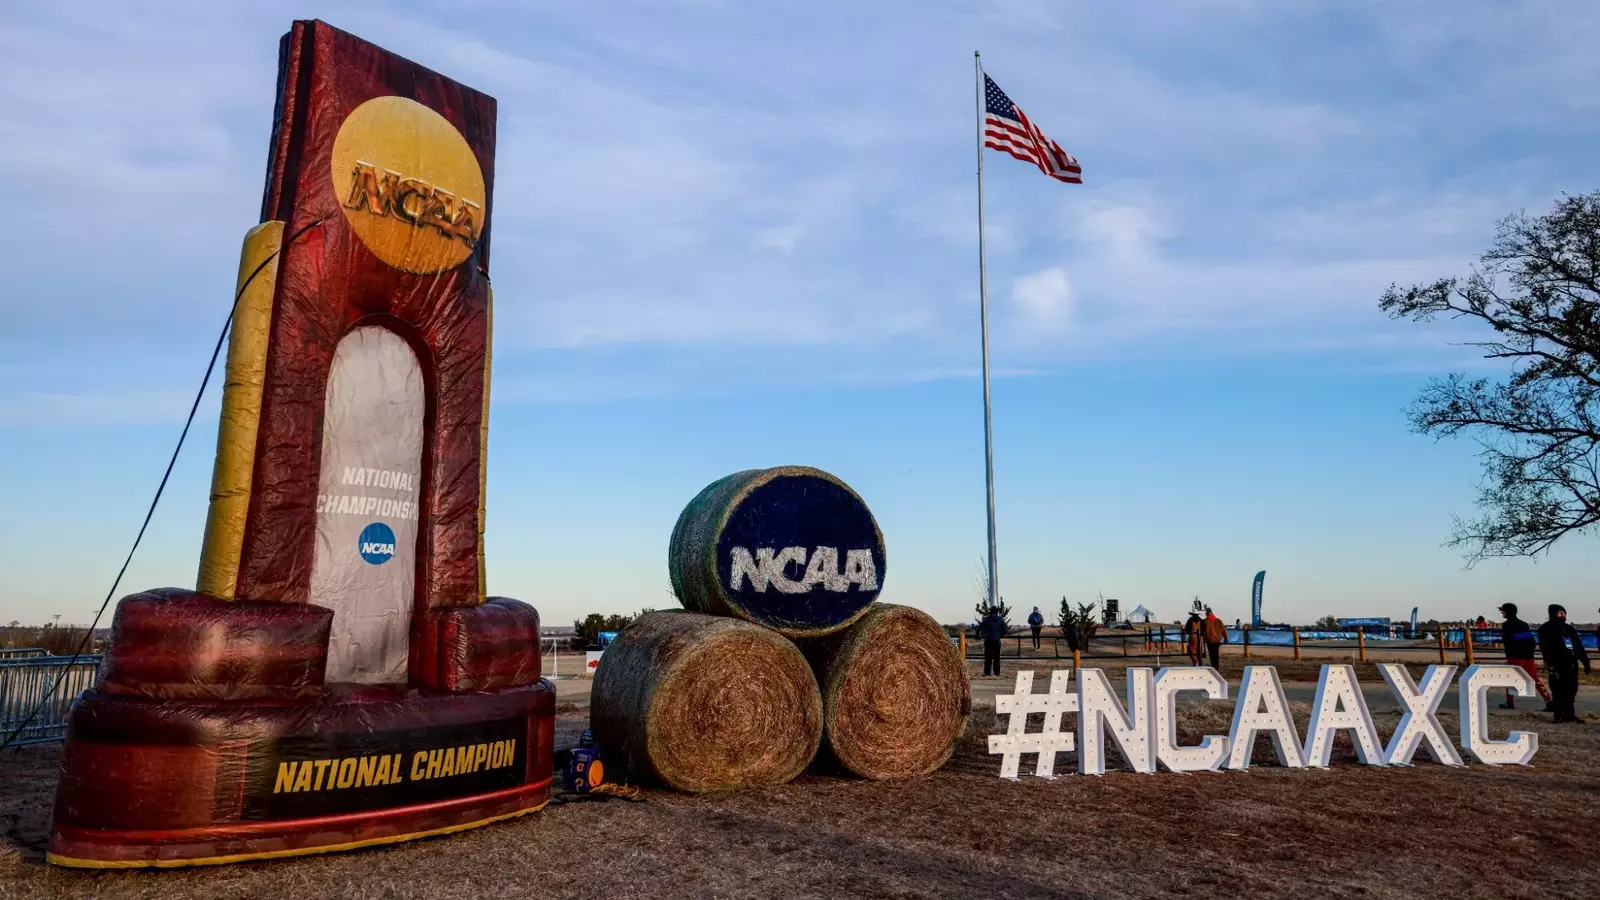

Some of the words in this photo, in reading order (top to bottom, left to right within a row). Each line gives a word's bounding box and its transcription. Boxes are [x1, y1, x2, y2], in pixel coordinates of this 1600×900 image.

[343, 160, 480, 248] NCAA
[342, 466, 413, 491] NATIONAL
[361, 542, 394, 555] NCAA
[729, 546, 878, 593] NCAA
[988, 664, 1538, 779] #NCAAXC
[273, 753, 403, 793] NATIONAL
[410, 739, 516, 781] CHAMPION
